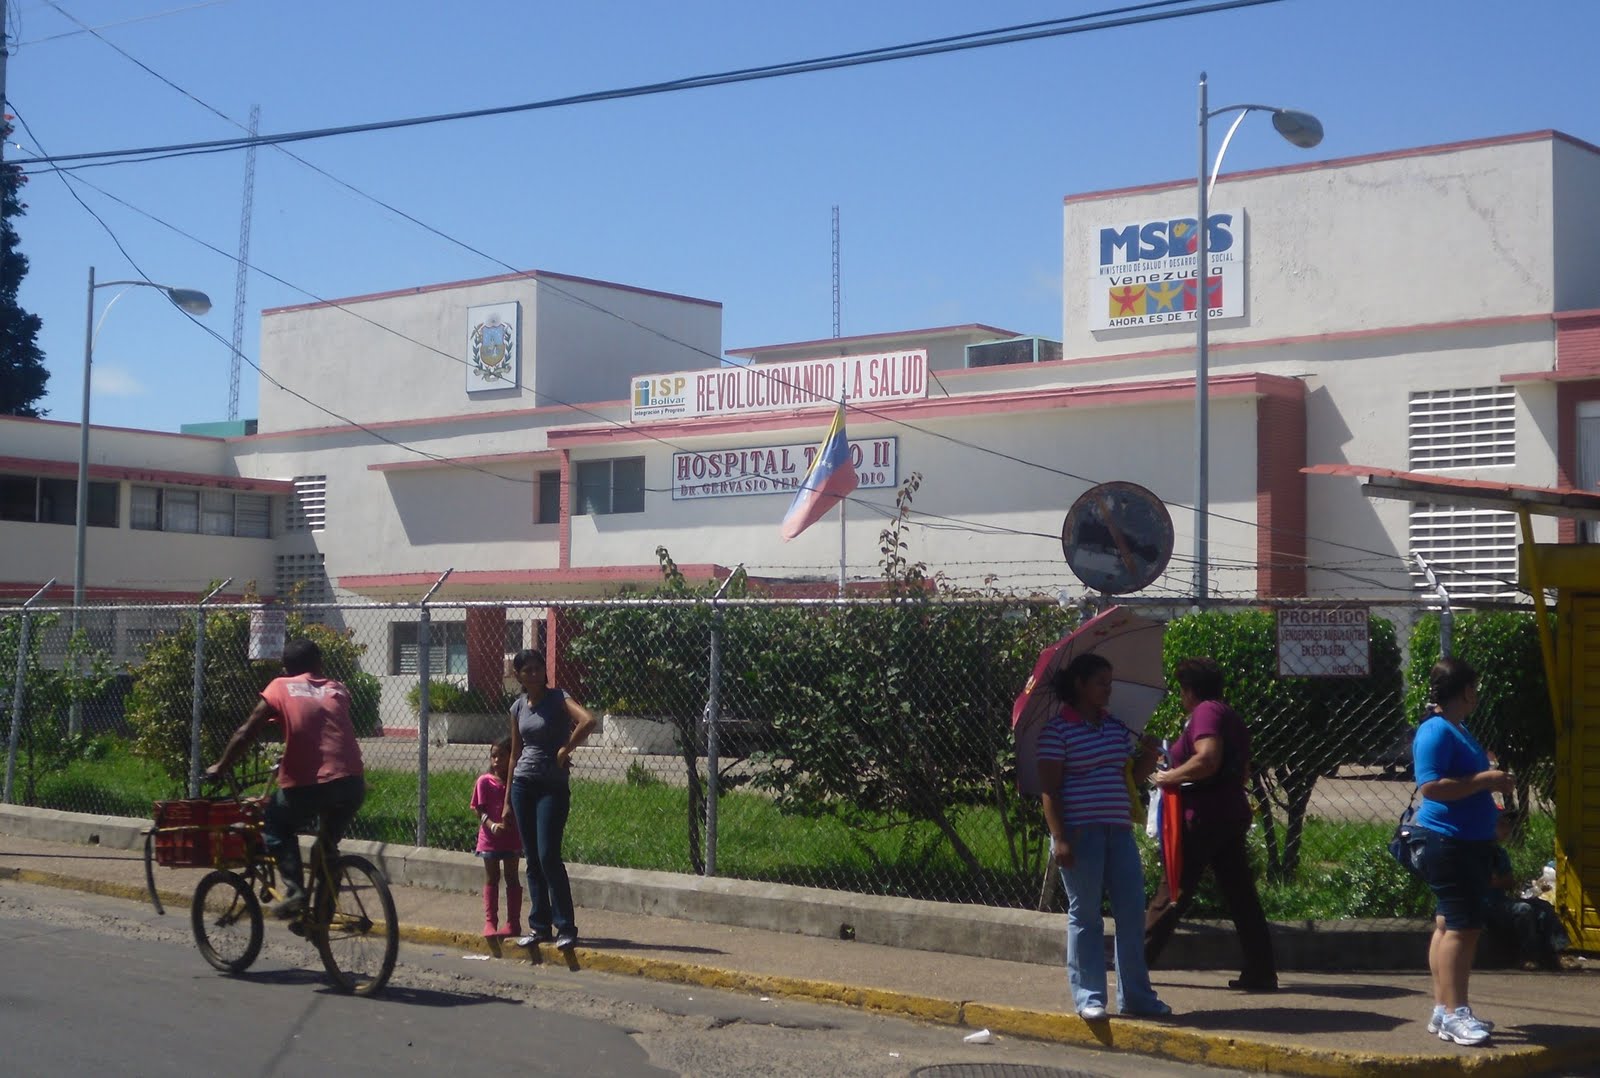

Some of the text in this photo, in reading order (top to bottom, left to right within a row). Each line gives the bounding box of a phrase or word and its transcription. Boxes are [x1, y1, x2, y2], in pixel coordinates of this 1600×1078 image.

[1100, 213, 1233, 266] MSDS
[1100, 262, 1132, 276] MINISTERIO
[1134, 261, 1141, 272] DE
[1143, 259, 1161, 270] SALUD
[1164, 259, 1168, 268] Y
[1211, 252, 1233, 263] SOCIAL
[1110, 266, 1223, 286] Venezuea
[1109, 315, 1144, 327] AHORA
[1149, 314, 1163, 324] ES
[1168, 312, 1182, 322] DE
[651, 355, 923, 412] ISP REVOLUCIONANDO LA SALUD
[677, 448, 796, 480] HOSPITAL
[803, 442, 864, 470] TO
[702, 480, 767, 495] GERVASIO
[1280, 610, 1365, 624] PROHIBIDO
[1281, 628, 1322, 641] VENDEDORES
